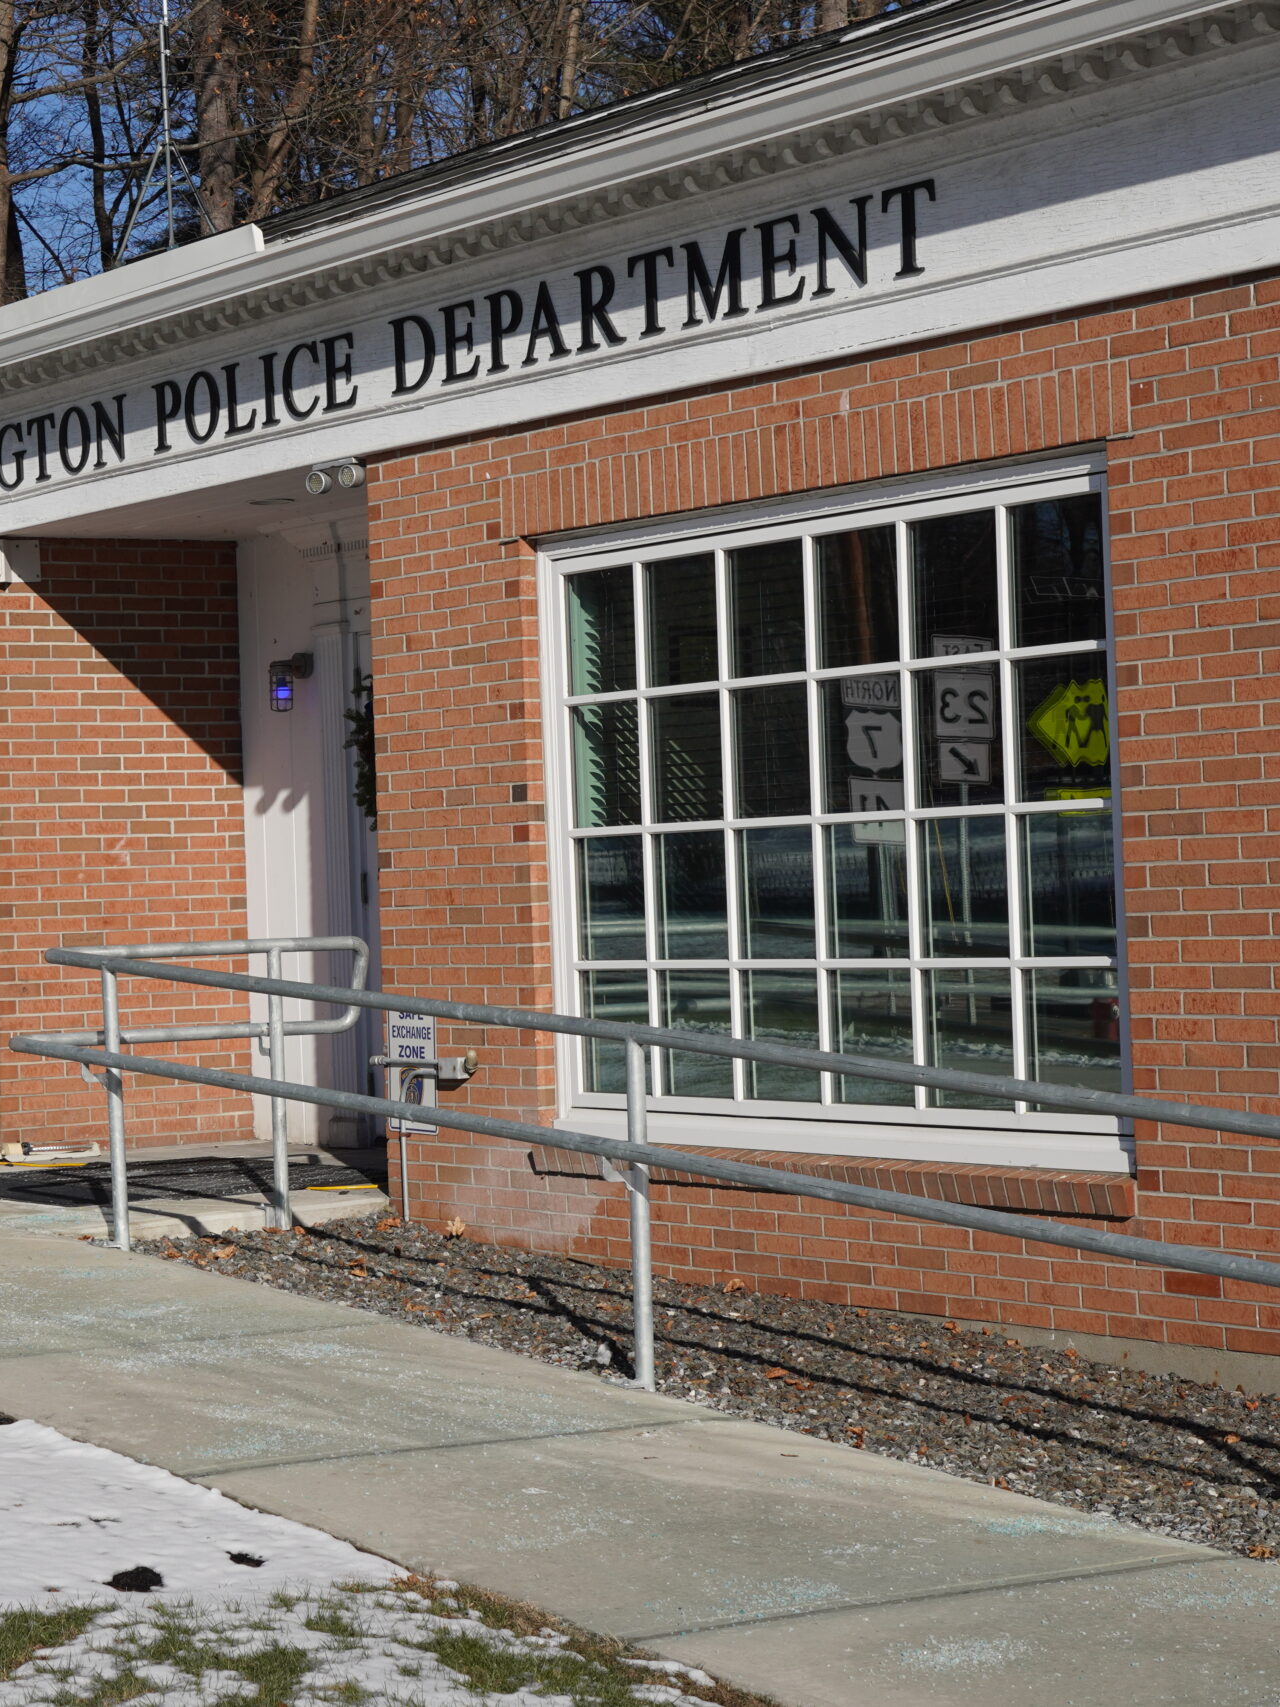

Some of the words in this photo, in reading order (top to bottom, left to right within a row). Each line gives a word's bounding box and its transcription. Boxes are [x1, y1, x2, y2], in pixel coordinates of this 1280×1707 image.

[152, 331, 359, 454] POLICE
[387, 178, 937, 396] DEPARTMENT
[392, 1025, 431, 1040] EXCHANGE
[398, 1045, 425, 1059] ZONE
